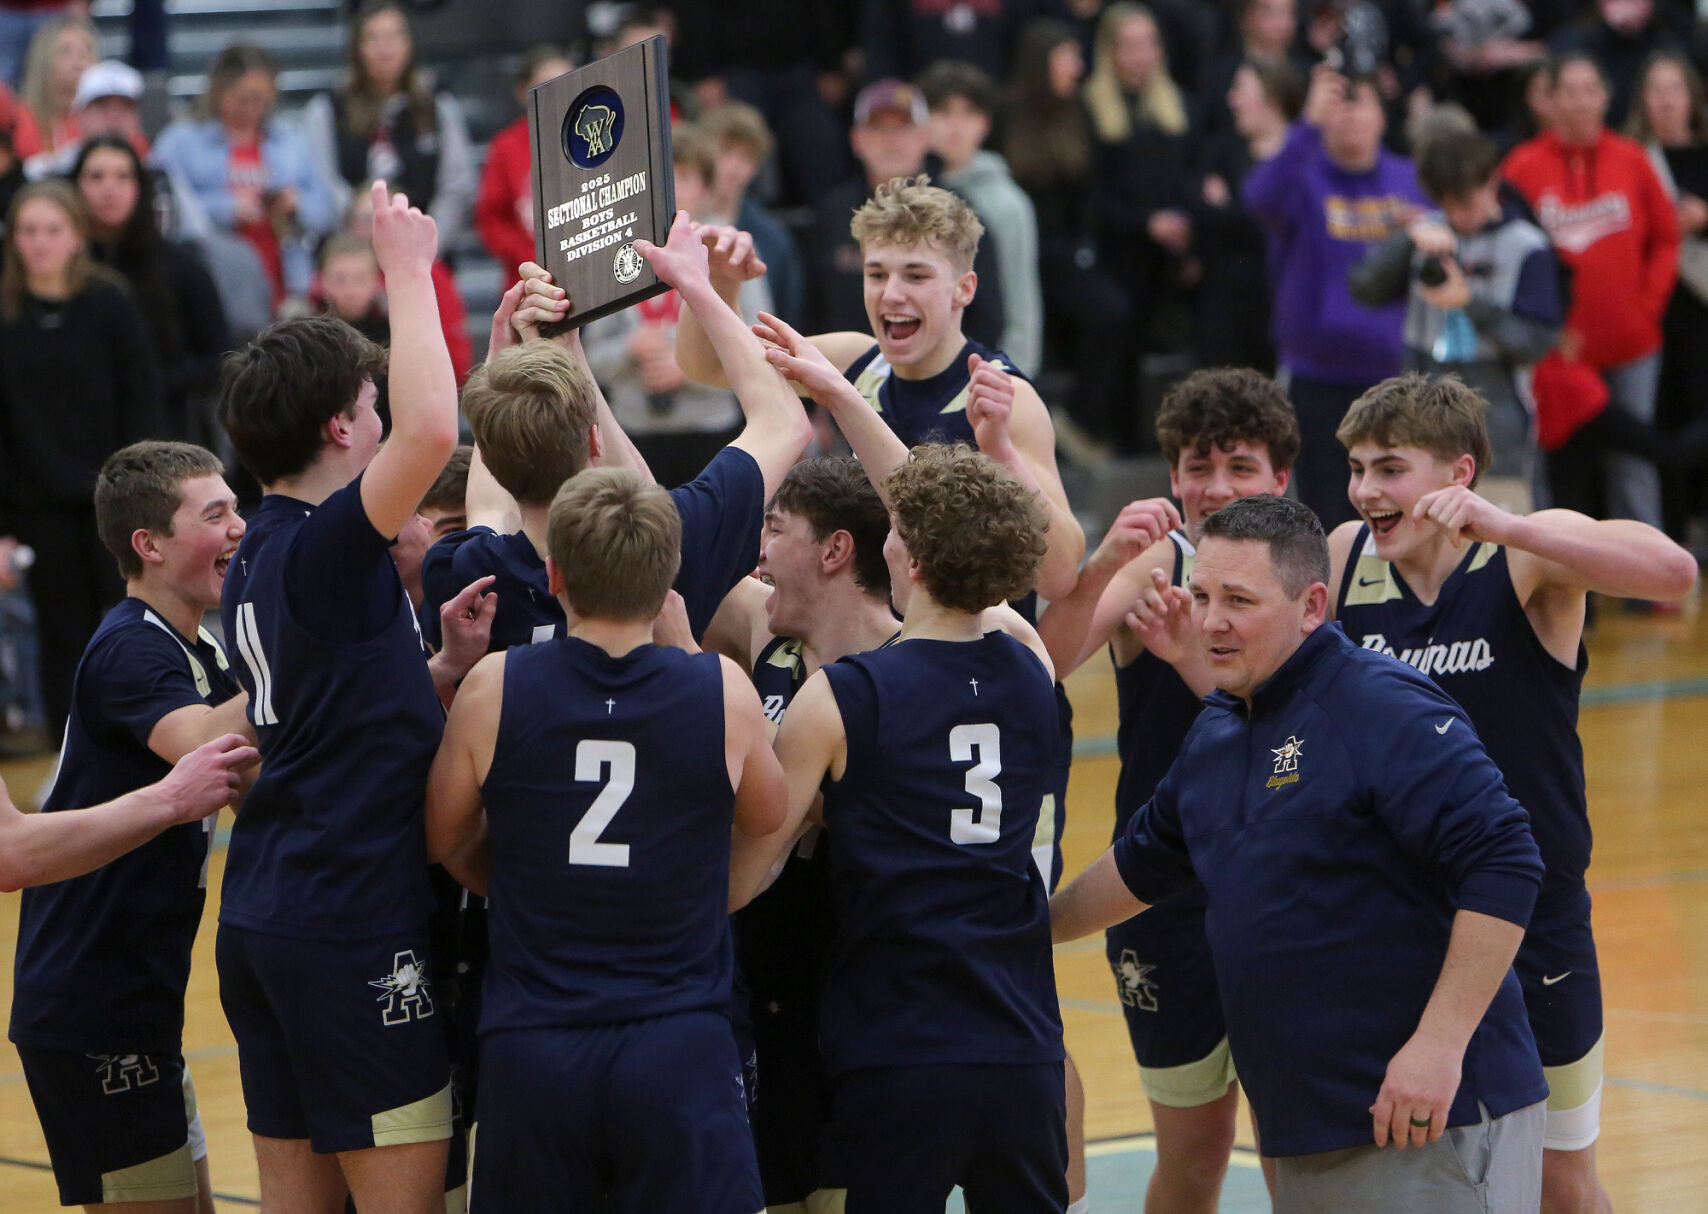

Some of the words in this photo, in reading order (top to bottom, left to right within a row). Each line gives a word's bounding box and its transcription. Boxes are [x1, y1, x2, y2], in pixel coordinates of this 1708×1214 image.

[547, 191, 598, 229] SECTIONAL
[599, 171, 646, 209] CHAMPION
[581, 173, 610, 193] 2025
[560, 212, 638, 251] BASKETBALL
[582, 208, 614, 230] BOYS
[566, 231, 623, 262] DIVISION
[624, 227, 633, 238] 4
[236, 602, 279, 726] 11
[1361, 633, 1495, 675] uinas
[568, 739, 636, 867] 2
[949, 723, 1002, 845] 3
[380, 949, 435, 1026] A
